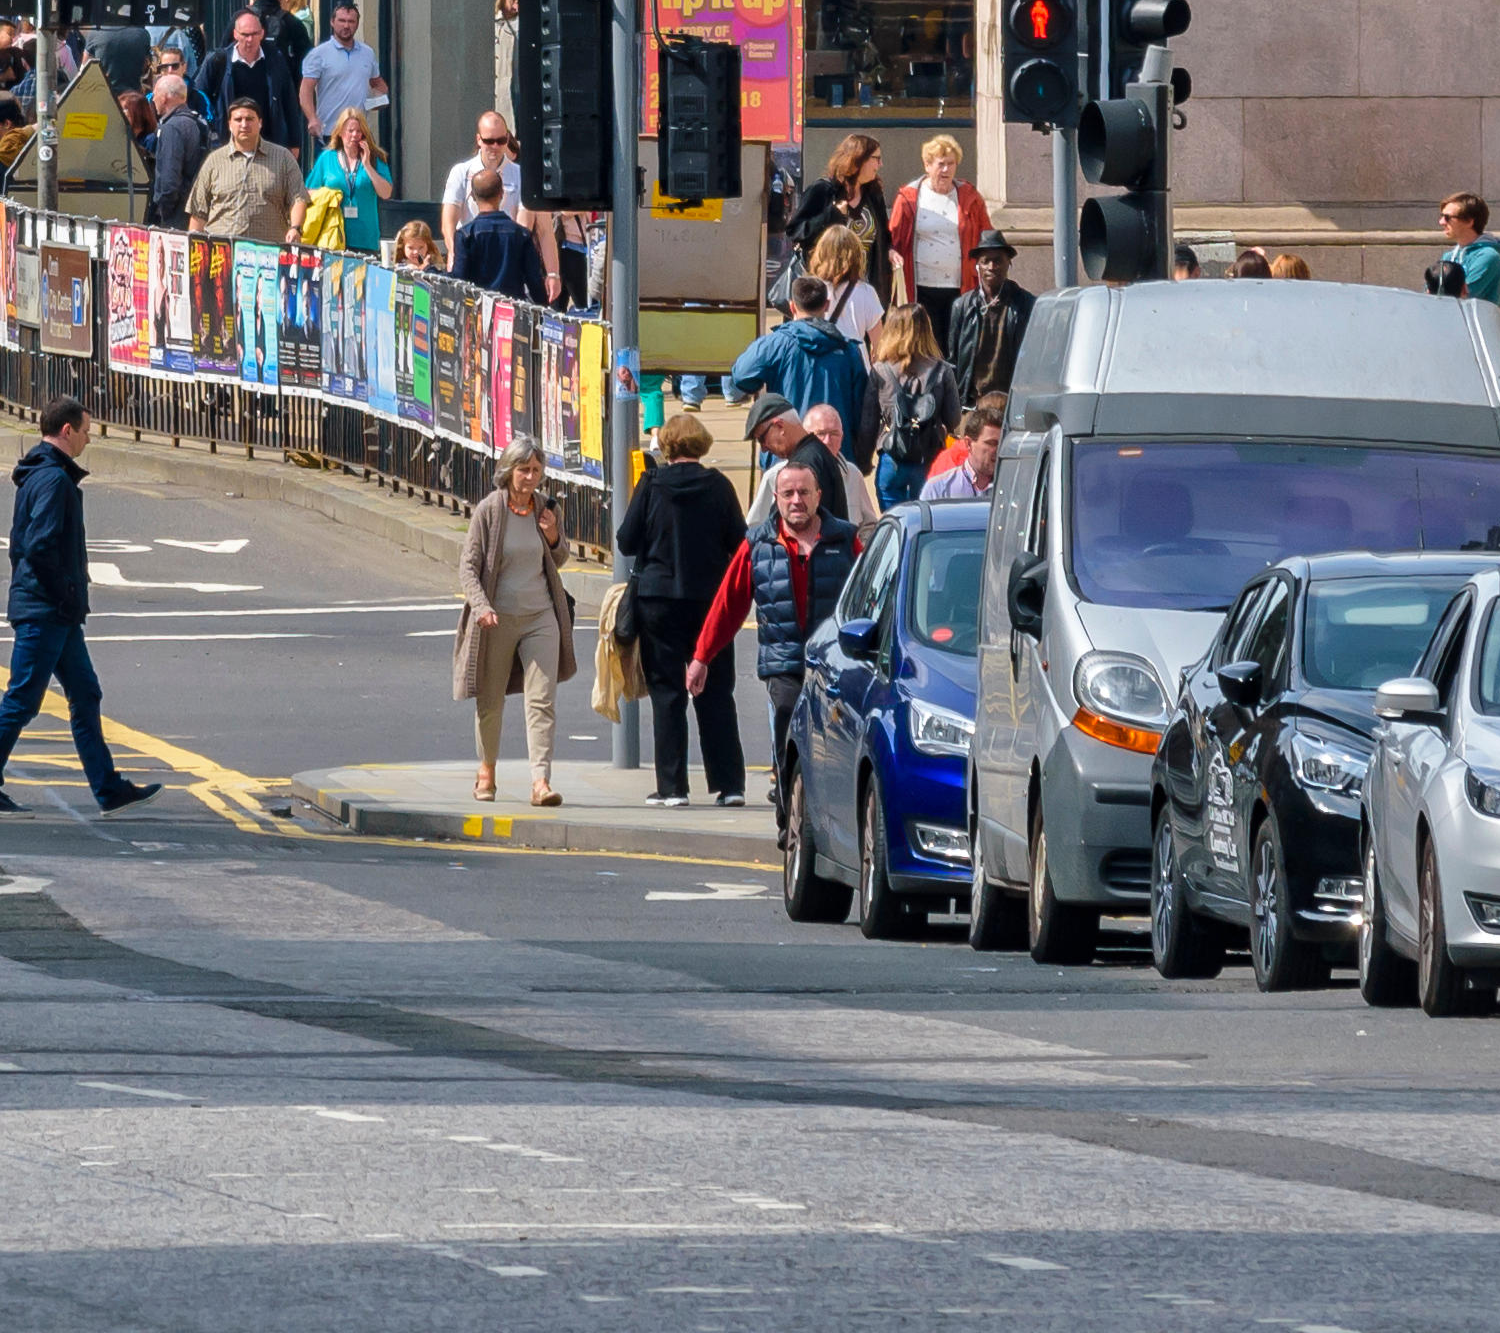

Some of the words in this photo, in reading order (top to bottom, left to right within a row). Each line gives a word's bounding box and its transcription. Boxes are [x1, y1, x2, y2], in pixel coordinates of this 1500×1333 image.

[675, 26, 713, 38] STORY
[715, 25, 731, 38] OF
[741, 91, 762, 108] 18
